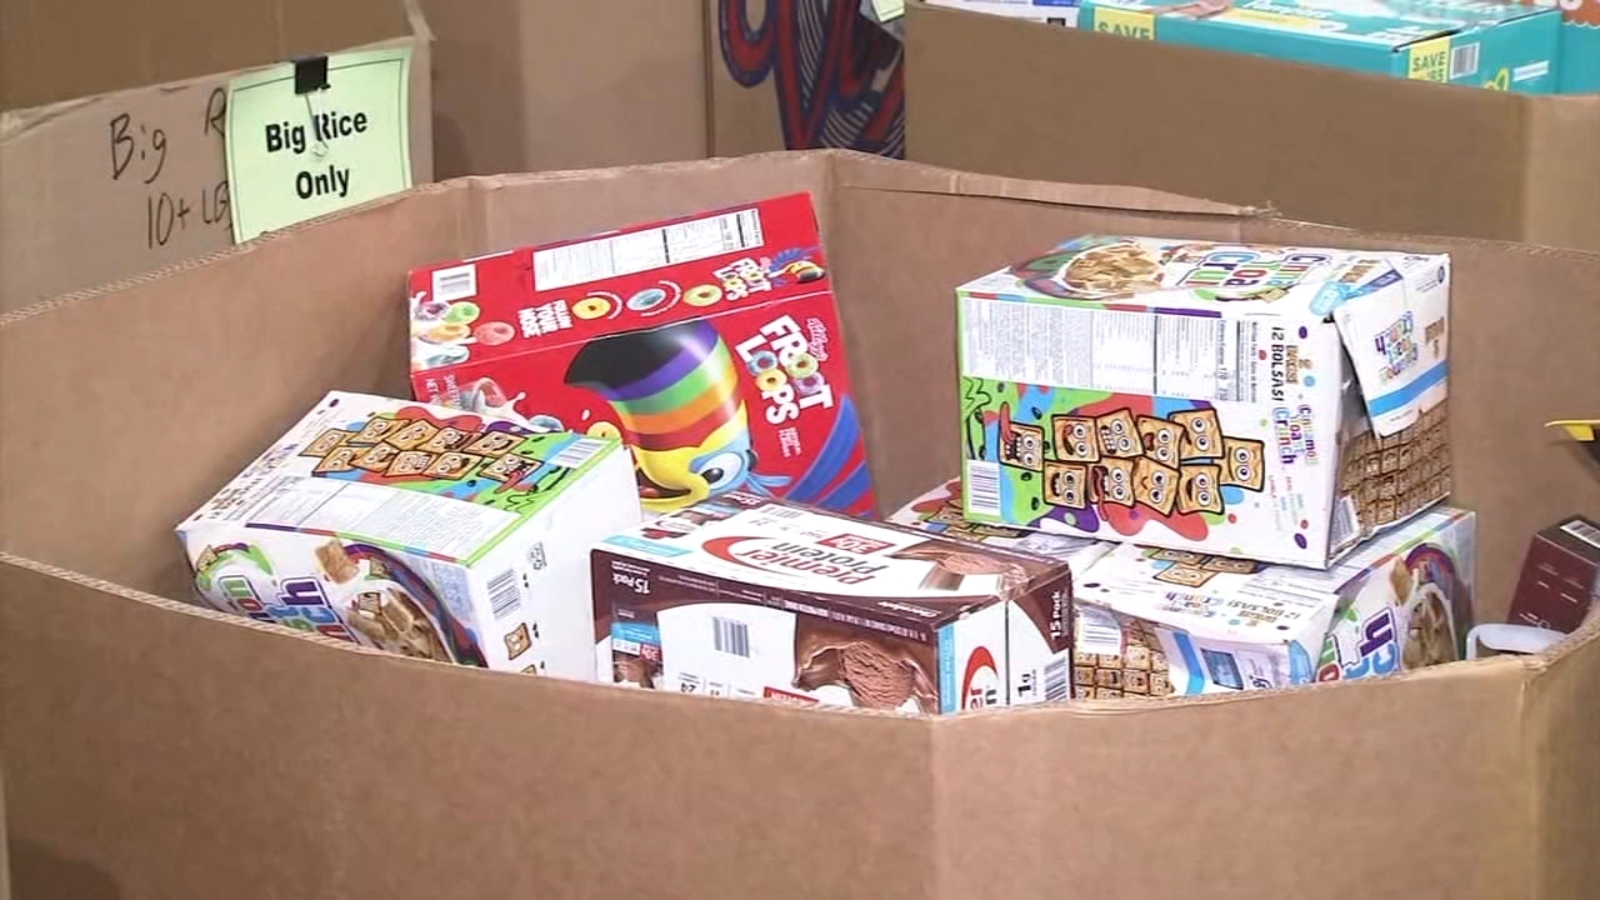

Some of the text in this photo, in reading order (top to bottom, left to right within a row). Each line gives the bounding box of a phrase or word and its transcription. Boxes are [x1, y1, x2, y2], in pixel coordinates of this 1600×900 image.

[1412, 51, 1446, 72] SAVE
[109, 112, 167, 185] Big
[265, 111, 368, 155] Big Rice
[295, 164, 351, 199] Only
[517, 307, 542, 339] NOSE
[735, 334, 801, 425] LOOPS
[759, 313, 834, 410] FROOT
[1273, 406, 1298, 466] Crunch
[734, 549, 876, 585] Premier
[771, 541, 890, 576] Protein
[612, 572, 633, 588] Pack
[634, 578, 650, 594] 15
[1050, 590, 1063, 641] 15 Pack
